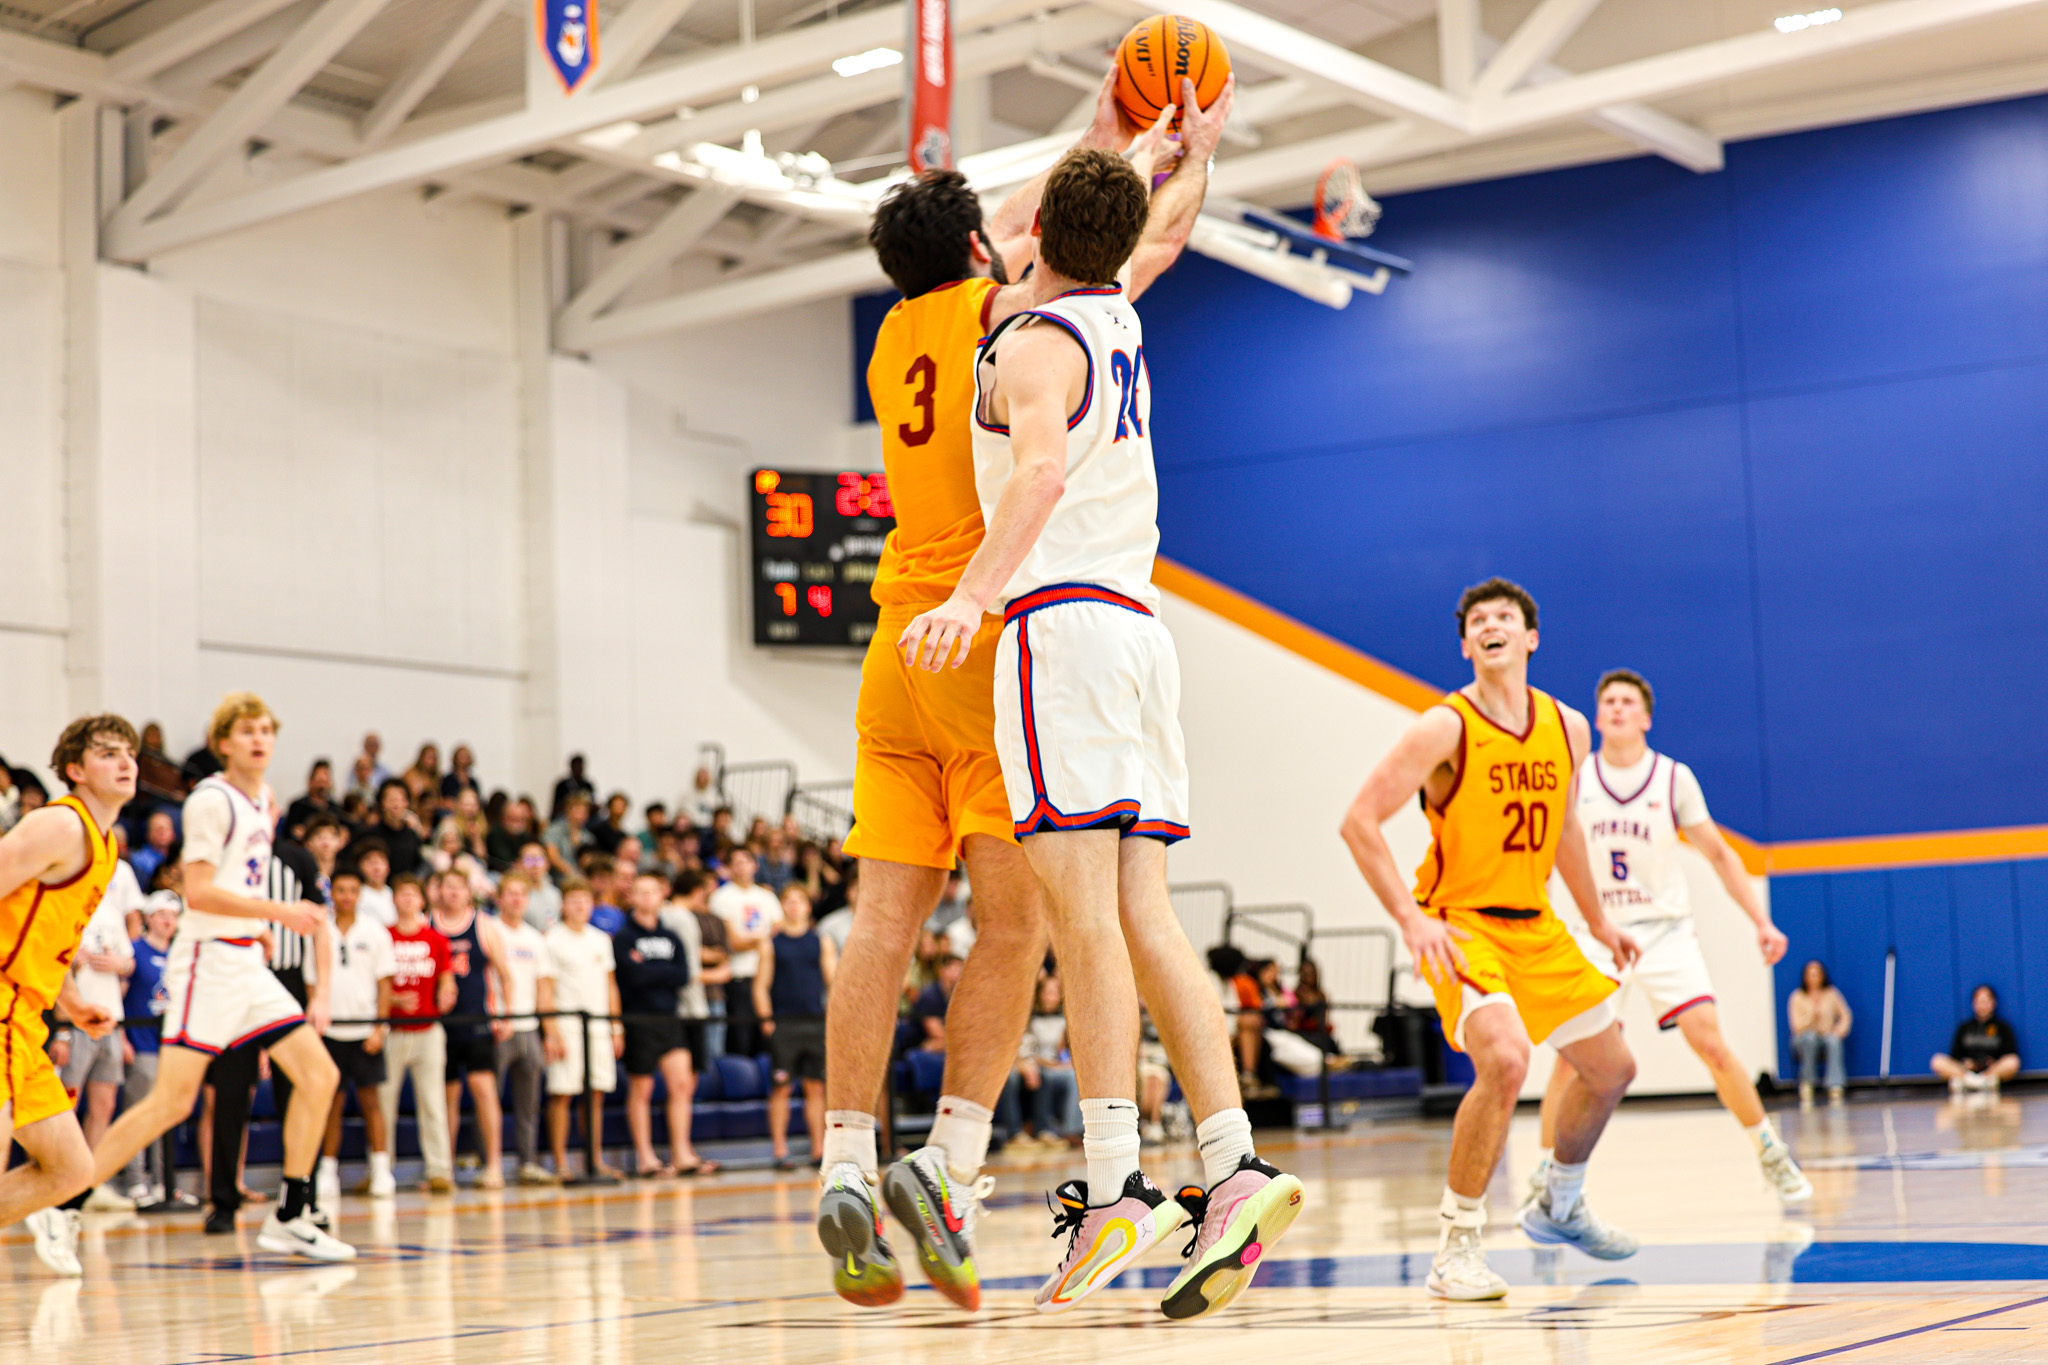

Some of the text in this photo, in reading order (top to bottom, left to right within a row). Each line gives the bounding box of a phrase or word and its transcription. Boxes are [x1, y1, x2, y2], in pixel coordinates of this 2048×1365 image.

[1174, 15, 1198, 77] Wilson
[898, 353, 937, 448] 3
[766, 492, 814, 538] 30
[1489, 761, 1558, 794] STAGS
[1503, 801, 1548, 854] 20
[1610, 850, 1628, 881] 5
